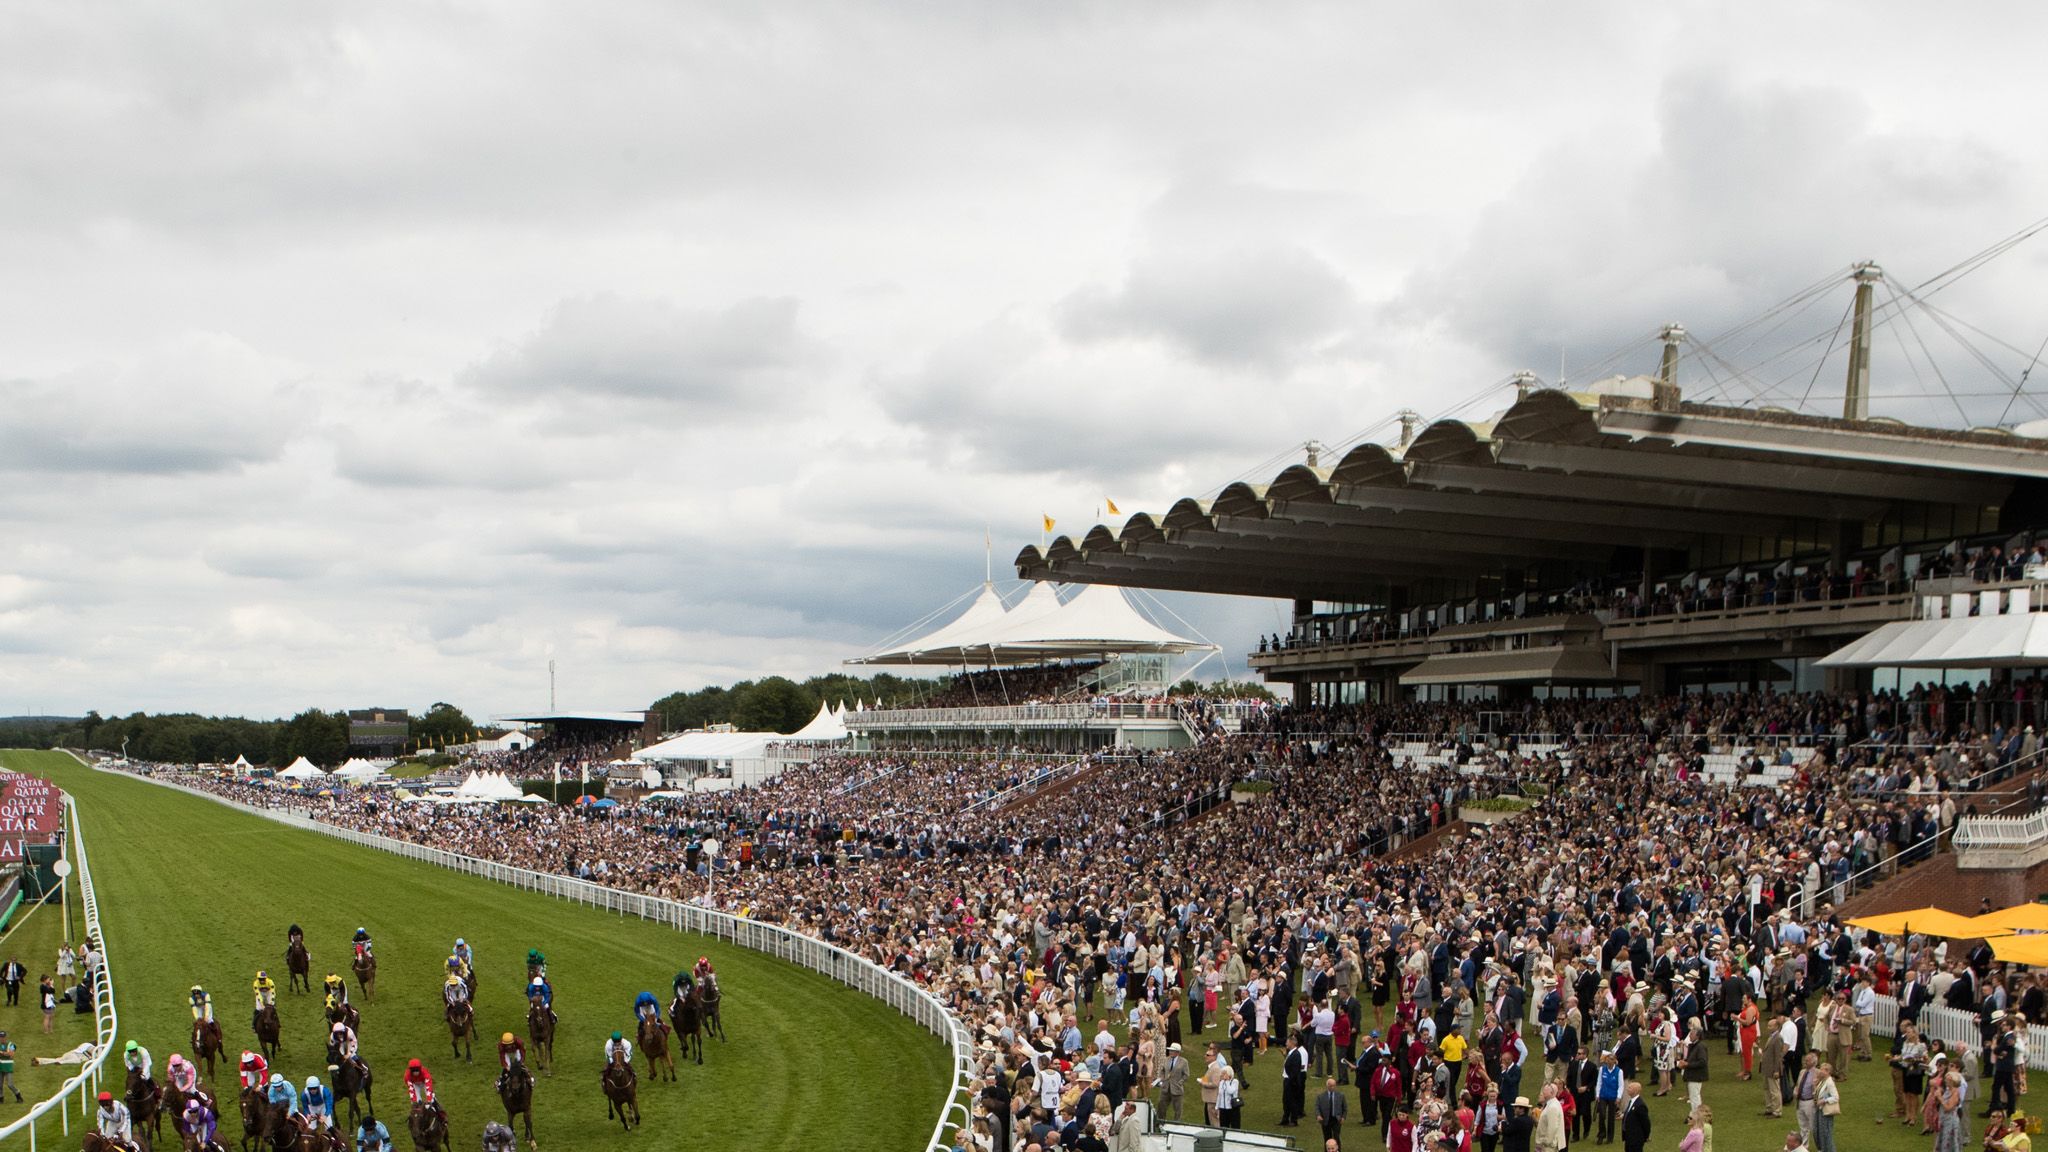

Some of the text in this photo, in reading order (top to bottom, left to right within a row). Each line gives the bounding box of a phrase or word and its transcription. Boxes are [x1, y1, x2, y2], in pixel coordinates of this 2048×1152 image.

[0, 773, 26, 781] QATAR
[17, 780, 44, 788] QATAR
[14, 787, 49, 798] QATAR
[1, 805, 45, 818] QATAR
[0, 818, 39, 831] TAR
